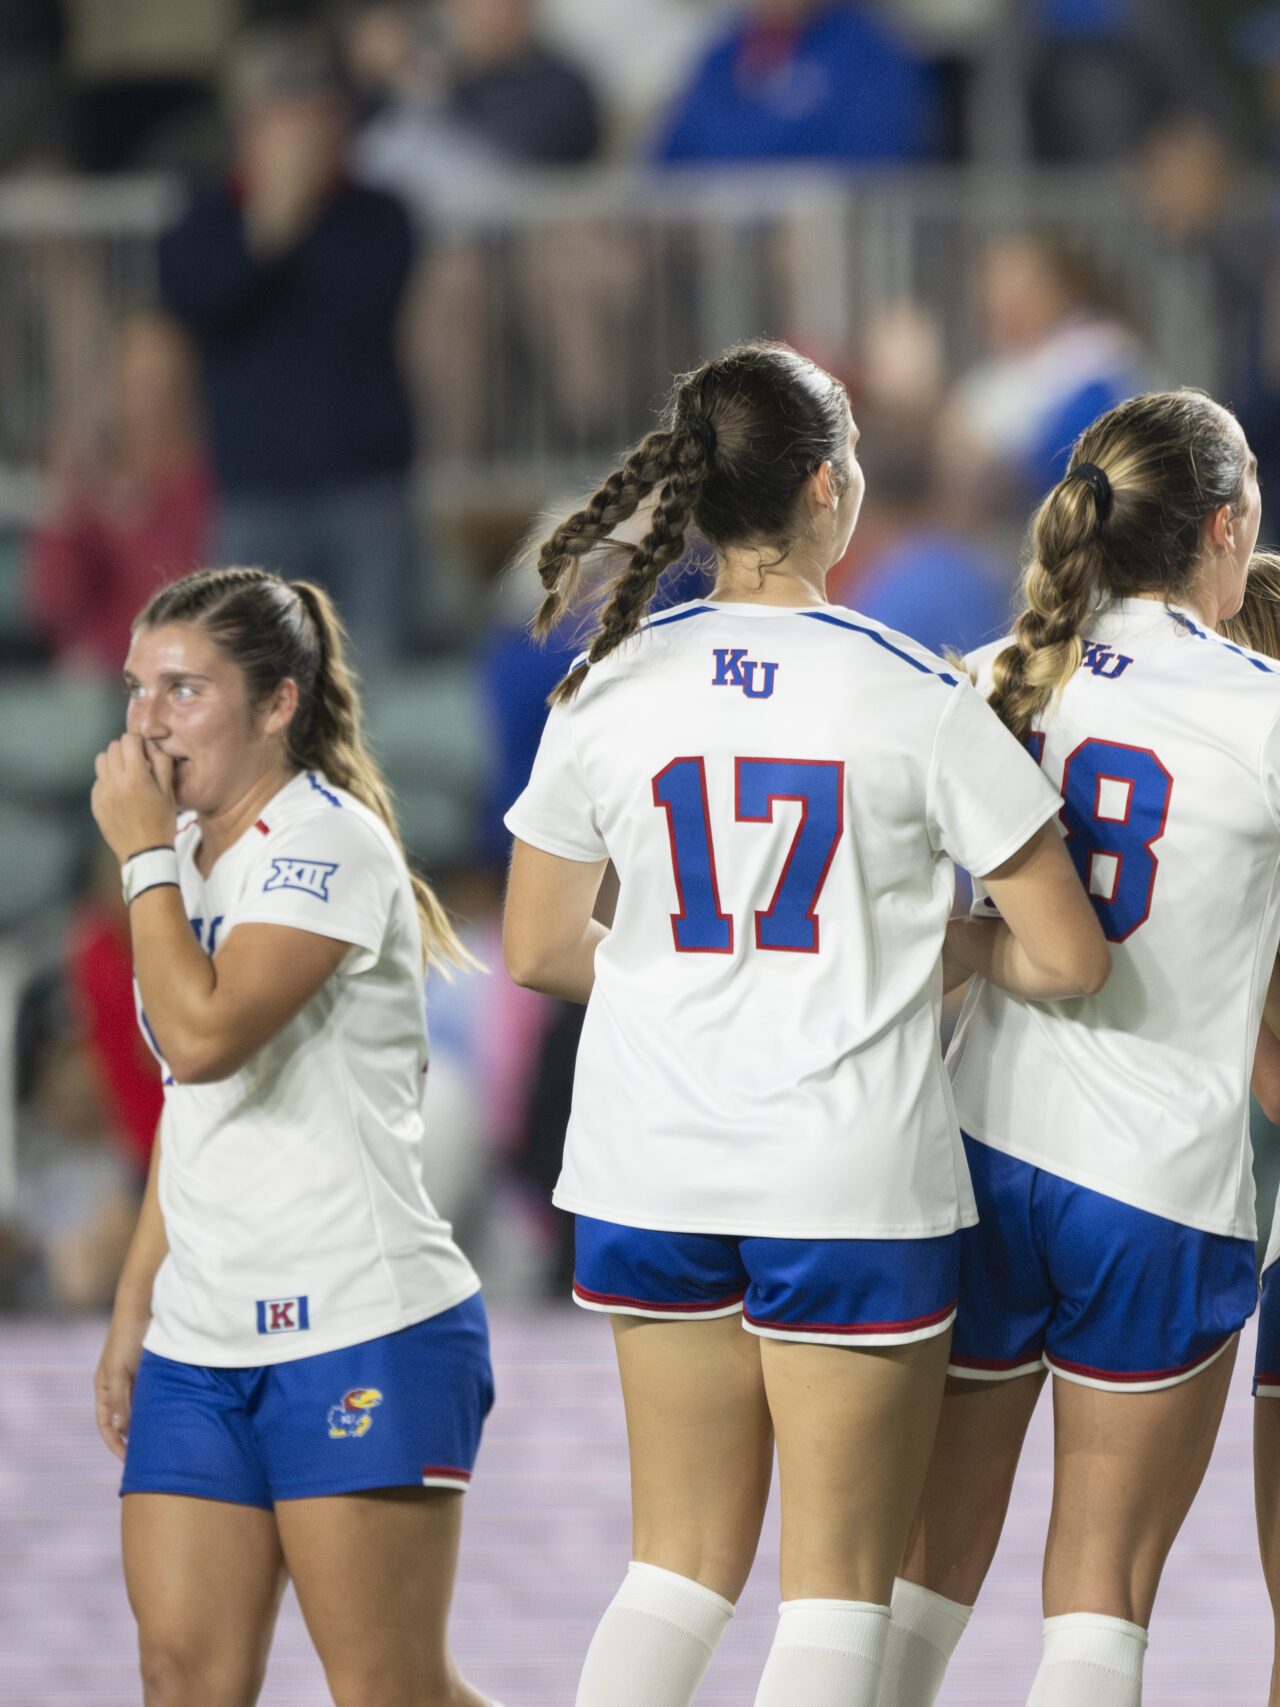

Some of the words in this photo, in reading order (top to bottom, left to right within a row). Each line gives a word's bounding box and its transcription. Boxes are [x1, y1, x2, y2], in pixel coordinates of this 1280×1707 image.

[712, 648, 779, 699] KU
[651, 755, 845, 954] 17
[1027, 730, 1174, 943] 8
[269, 1302, 294, 1330] K
